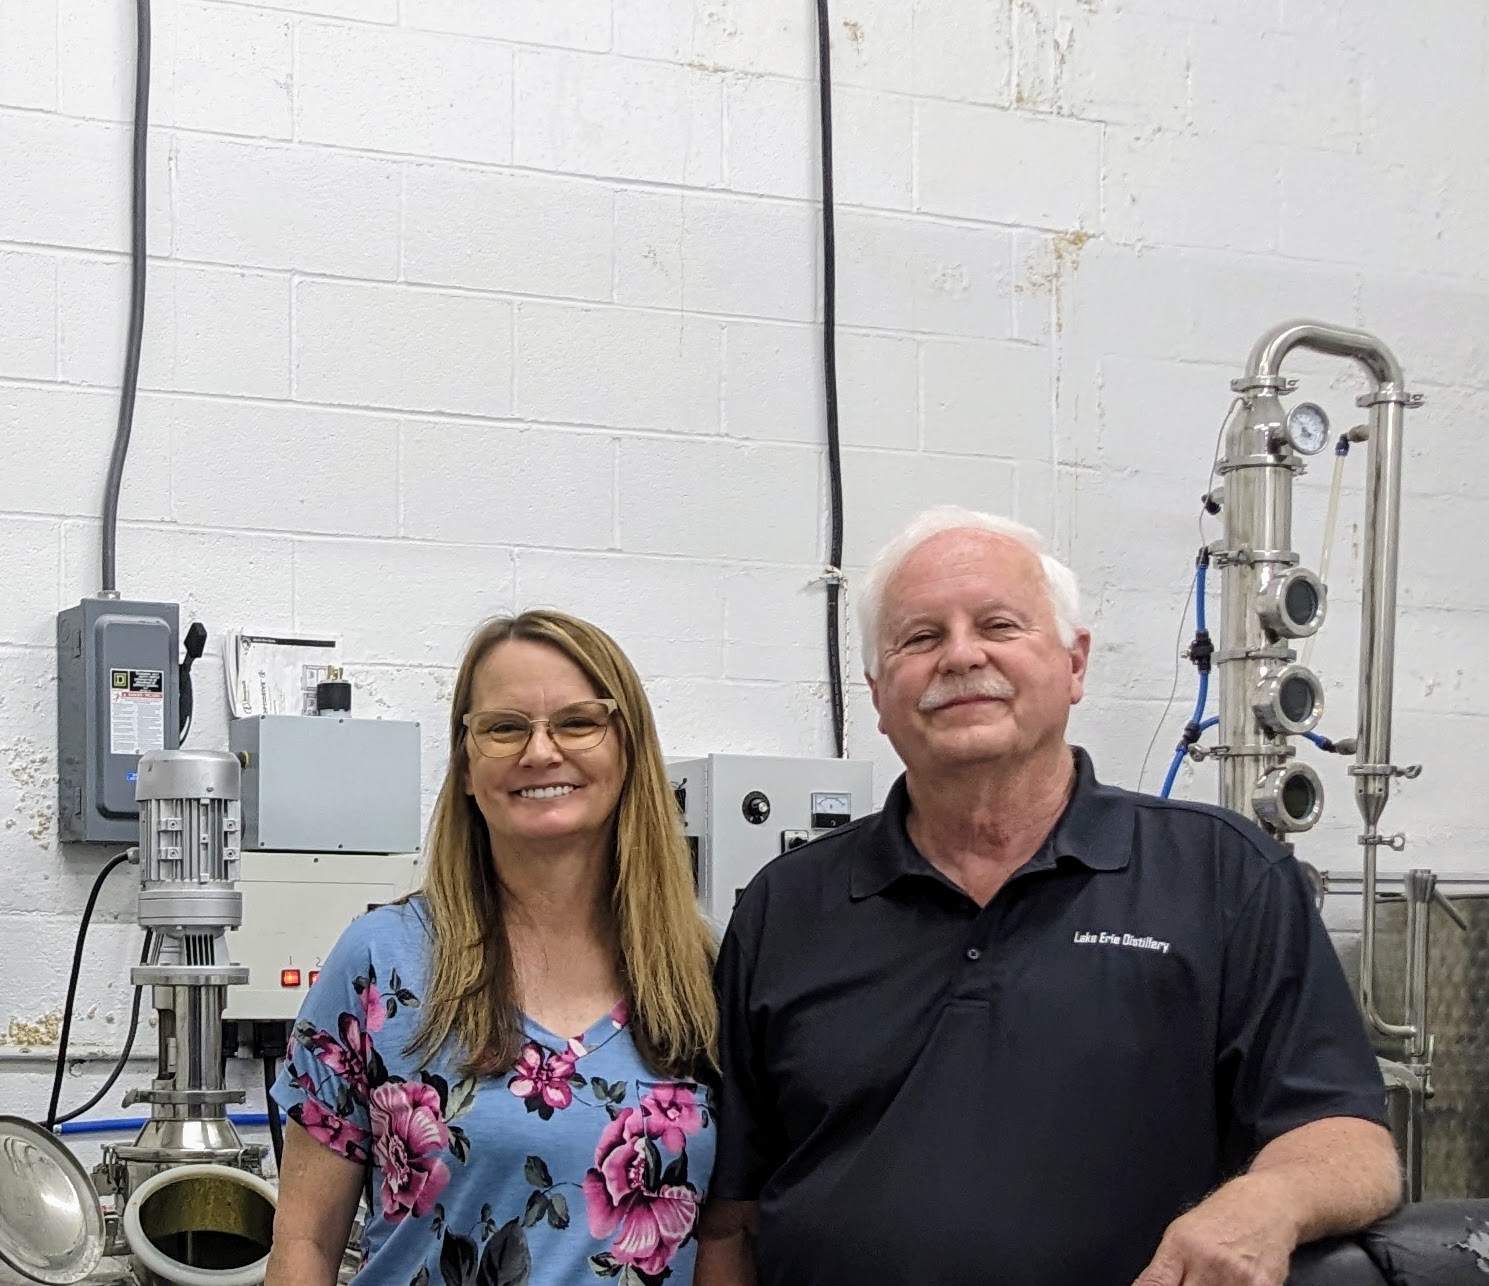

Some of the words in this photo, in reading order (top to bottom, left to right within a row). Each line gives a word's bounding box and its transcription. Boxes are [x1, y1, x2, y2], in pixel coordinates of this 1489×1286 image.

[1073, 931, 1098, 944] Lake
[1099, 931, 1121, 945] Erie
[1122, 933, 1171, 954] Distillery
[315, 956, 323, 968] 2
